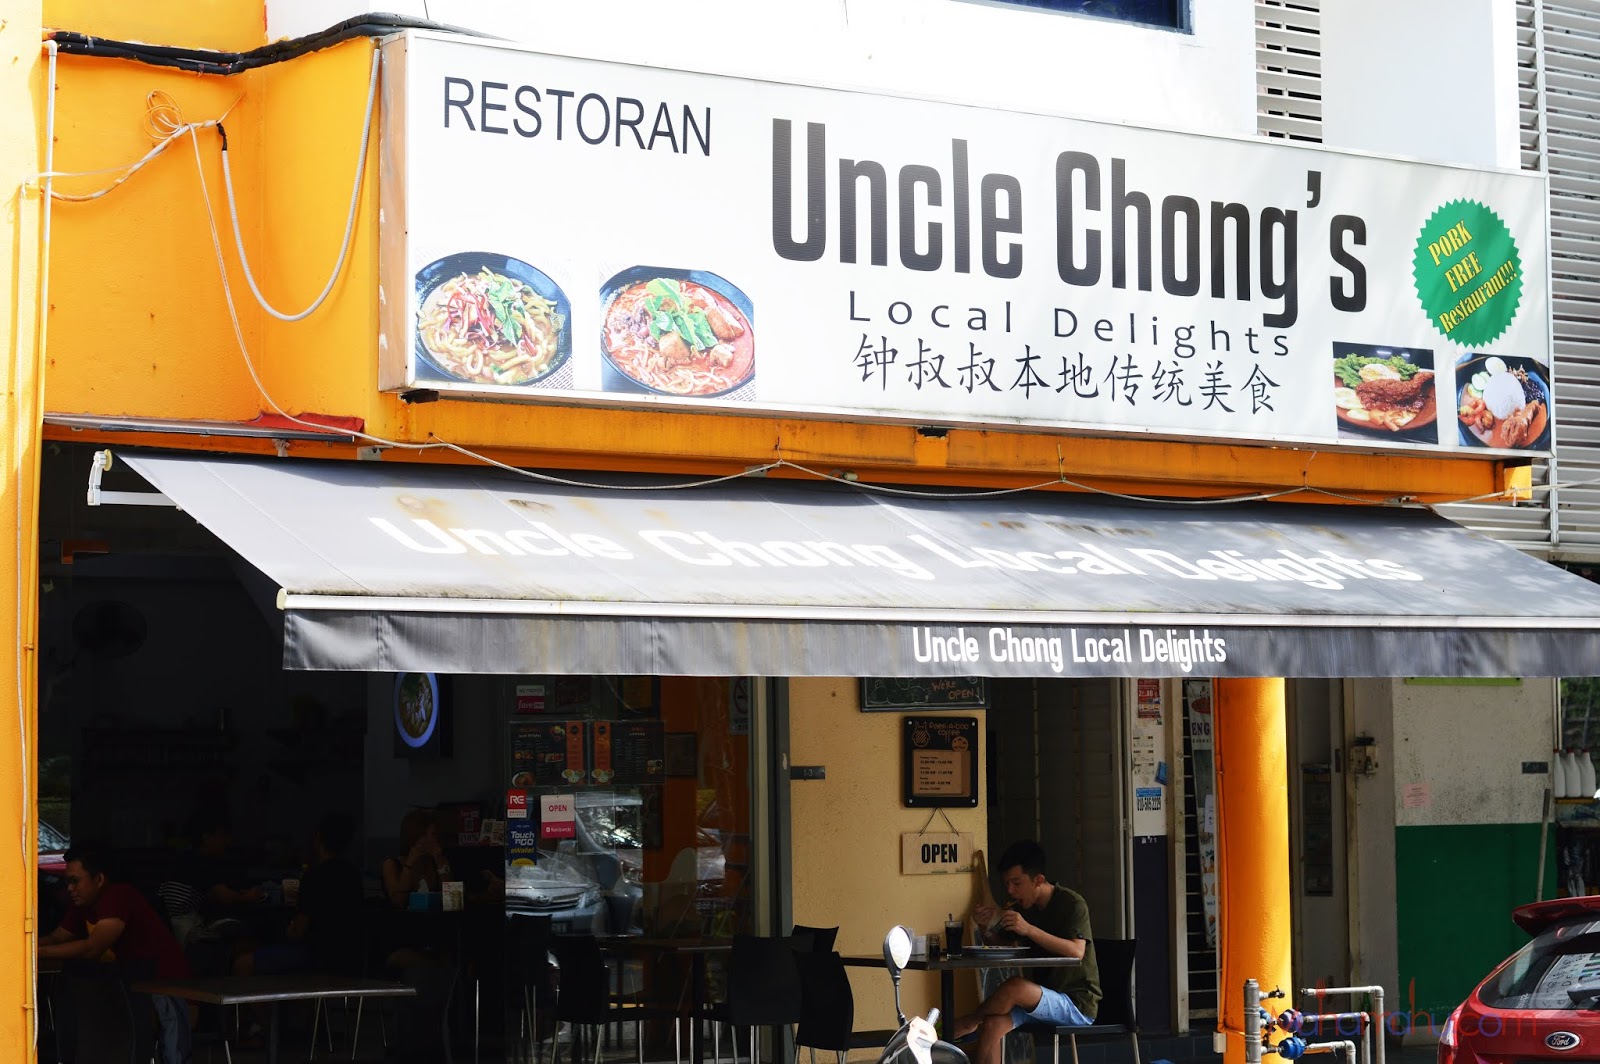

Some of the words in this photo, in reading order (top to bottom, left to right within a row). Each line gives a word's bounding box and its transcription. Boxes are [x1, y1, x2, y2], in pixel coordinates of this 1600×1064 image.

[444, 76, 711, 157] RESTORAN
[771, 118, 1023, 279] Uncle
[1055, 149, 1367, 329] Chong's
[1427, 220, 1473, 267] PORK
[1439, 259, 1518, 334] Restaurant!!!
[1444, 251, 1483, 293] FREE
[849, 290, 1011, 333] Local
[1054, 307, 1289, 359] Delights
[852, 333, 1281, 415] 钟叔叔本地传统美食
[368, 516, 635, 560] Uncle
[637, 530, 935, 581] Chong
[907, 534, 1147, 575] Local
[1125, 547, 1424, 590] Delights
[912, 626, 980, 664] Uncle
[988, 627, 1064, 674] Chong
[1071, 628, 1133, 664] Local
[1139, 628, 1227, 673] Delights
[510, 830, 535, 839] Touch
[548, 804, 567, 812] OPEN
[921, 843, 958, 864] OPEN
